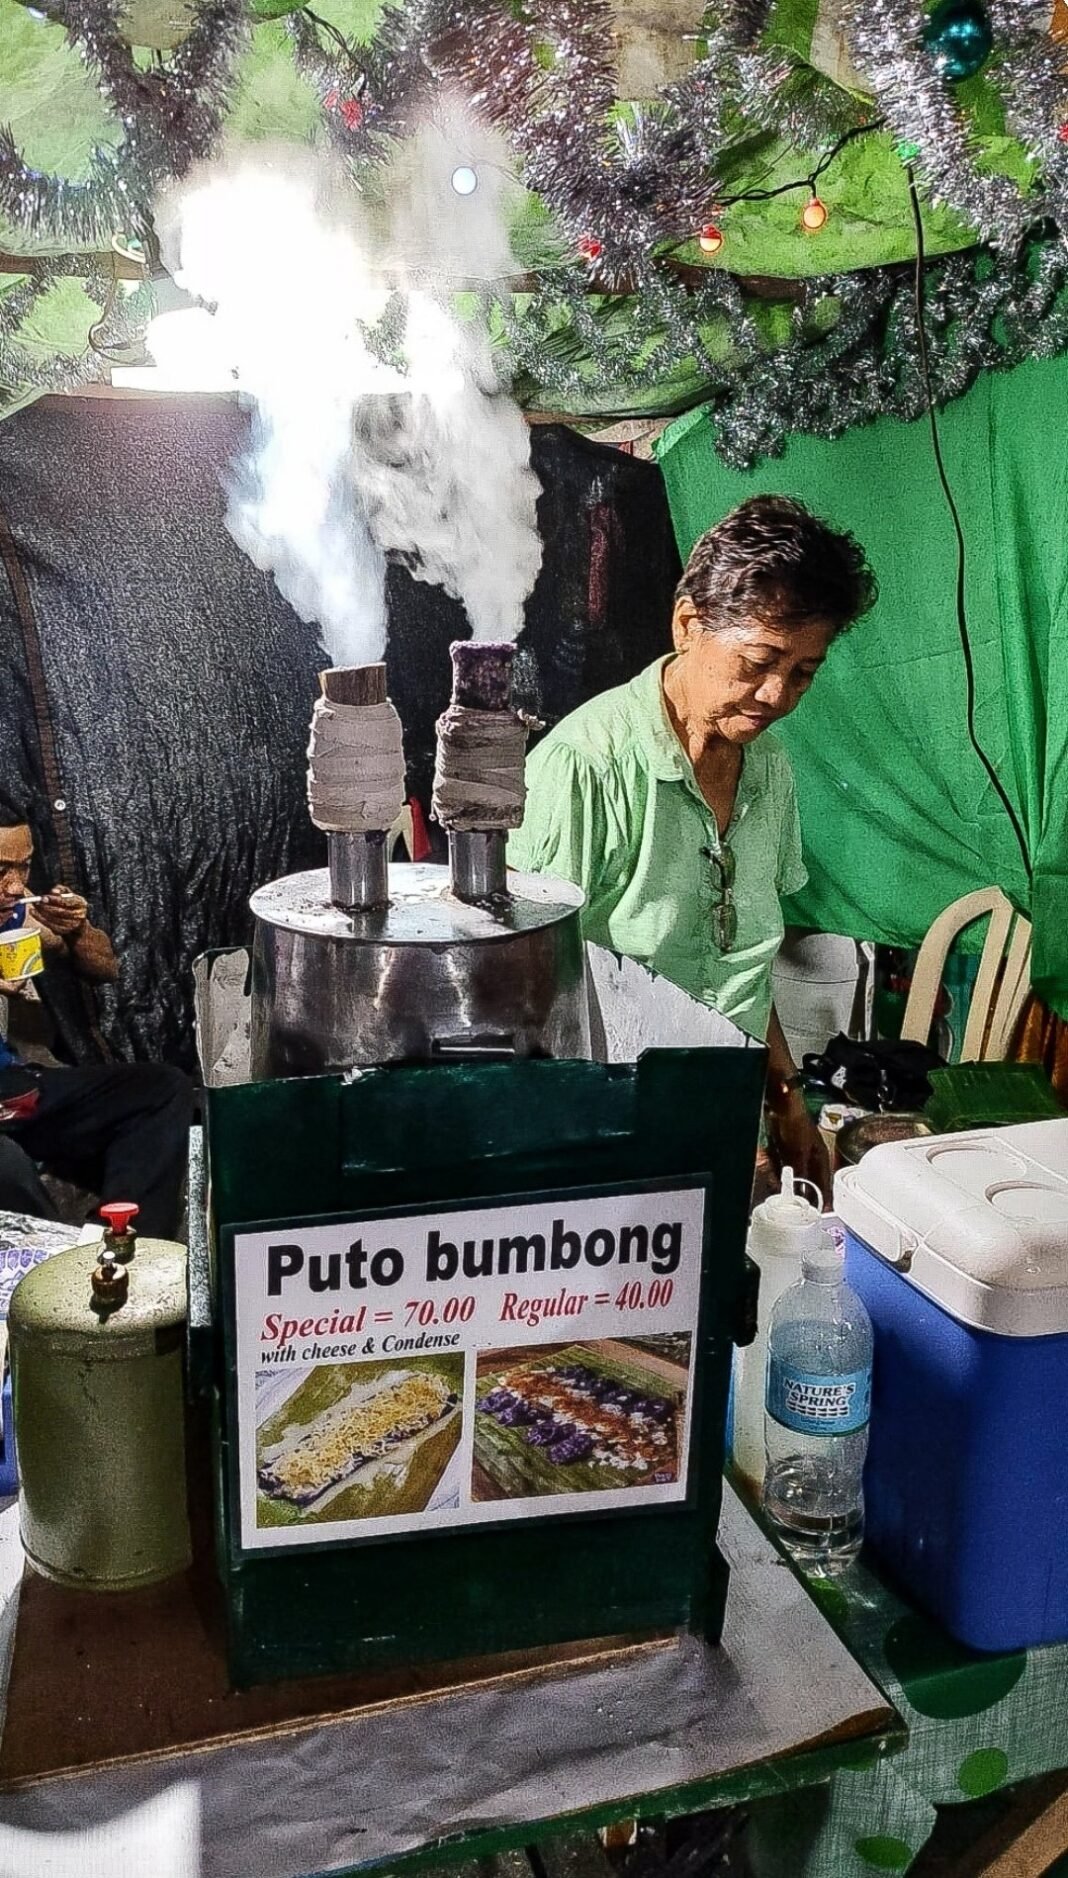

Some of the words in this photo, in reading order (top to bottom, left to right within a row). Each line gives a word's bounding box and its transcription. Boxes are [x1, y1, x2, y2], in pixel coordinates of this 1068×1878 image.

[267, 1238, 404, 1296] Puto
[426, 1219, 682, 1282] bumbong
[260, 1306, 366, 1349] Special
[404, 1296, 475, 1328] 70.00
[499, 1288, 588, 1327] Regular
[261, 1345, 296, 1364] with
[302, 1342, 357, 1360] cheese
[361, 1337, 375, 1354] &
[382, 1332, 460, 1352] Condense
[784, 1379, 855, 1397] NATURE'S
[790, 1391, 848, 1407] SPRING
